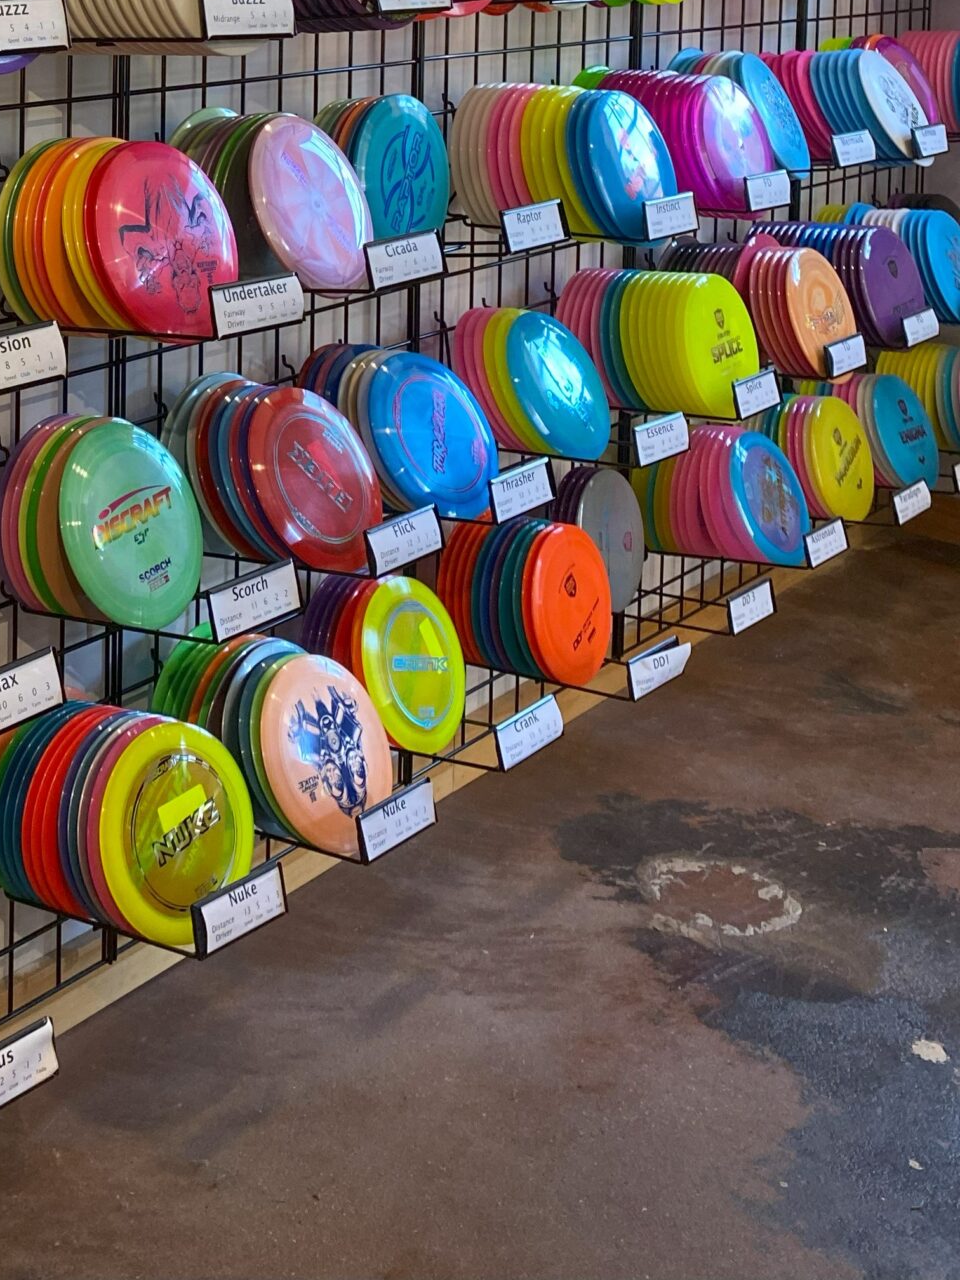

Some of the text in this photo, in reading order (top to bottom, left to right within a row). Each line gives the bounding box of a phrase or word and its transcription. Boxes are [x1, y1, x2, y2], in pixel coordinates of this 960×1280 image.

[656, 201, 681, 214] Instinct
[517, 210, 541, 225] Raptor
[385, 241, 418, 258] Cicada
[222, 282, 287, 303] Undertaker
[710, 336, 743, 363] SPLICE
[745, 380, 762, 393] Splice
[647, 423, 674, 438] Essence
[501, 471, 535, 492] Thrasher
[92, 486, 171, 551] DISCRAFT
[392, 519, 416, 538] Flick
[139, 557, 171, 583] SCORCH
[232, 577, 268, 601] Scorch
[653, 654, 669, 670] DD1
[514, 711, 539, 733] Crank
[382, 800, 406, 819] Nuke
[152, 796, 221, 868] NUKE
[228, 883, 257, 907] Nuke
[212, 917, 234, 933] Distance
[215, 929, 232, 942] Driver
